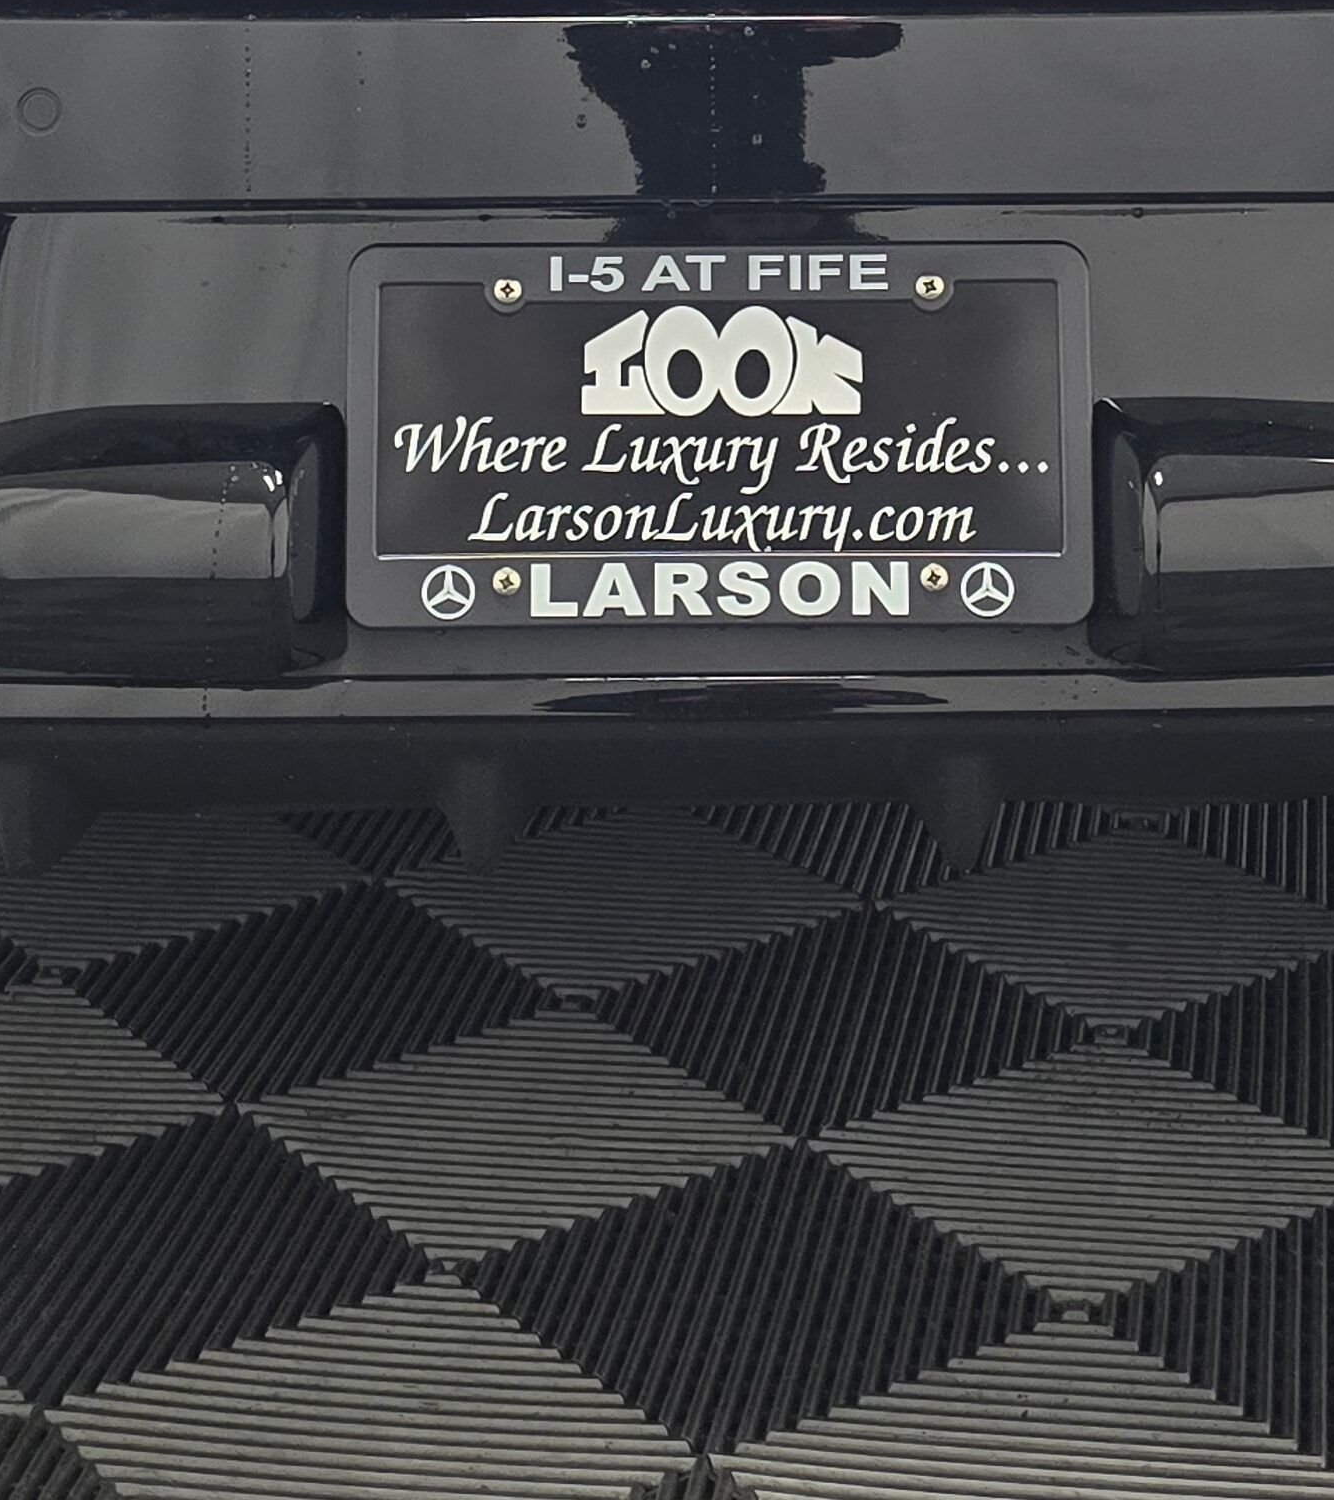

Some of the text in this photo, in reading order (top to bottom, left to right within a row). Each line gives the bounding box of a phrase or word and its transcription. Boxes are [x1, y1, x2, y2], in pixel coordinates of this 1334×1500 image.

[549, 252, 890, 293] I-5 AT FIFE
[580, 304, 864, 417] LOOK
[394, 416, 1050, 495] Where Luxury Resides...
[467, 490, 977, 553] LarsonLuxury.com
[529, 560, 911, 618] LARSON
